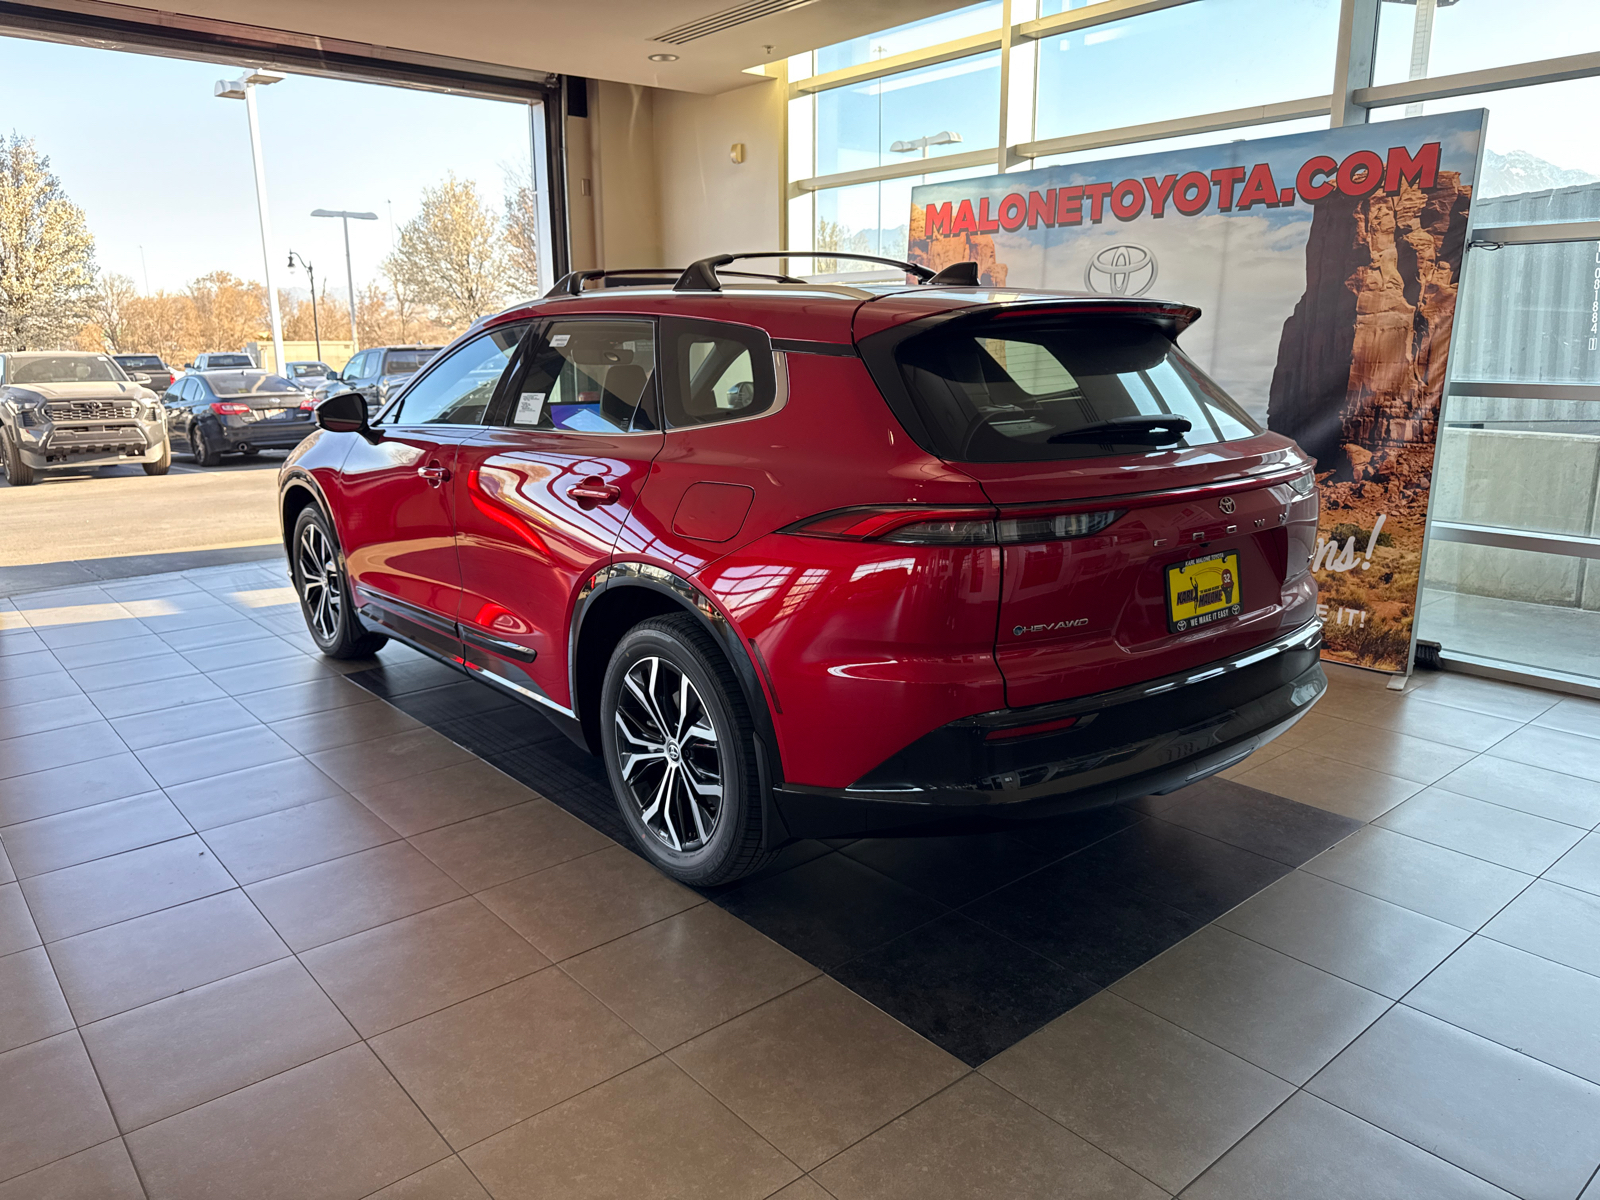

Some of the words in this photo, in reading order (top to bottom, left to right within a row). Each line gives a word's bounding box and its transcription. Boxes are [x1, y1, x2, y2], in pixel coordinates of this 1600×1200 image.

[925, 142, 1442, 237] MALONETOYOTA.COM
[1153, 512, 1287, 547] CROWN
[1311, 513, 1387, 573] ns!
[1223, 573, 1231, 583] 32
[1176, 589, 1194, 606] KARL
[1198, 590, 1223, 608] MALONE
[1023, 622, 1055, 633] HEV
[1054, 617, 1089, 630] AWD
[1190, 618, 1198, 627] WE
[1198, 613, 1212, 624] MAKE
[1212, 612, 1217, 620] IT
[1217, 608, 1229, 619] EASY
[1316, 604, 1329, 621] E
[1336, 605, 1367, 629] IT!
